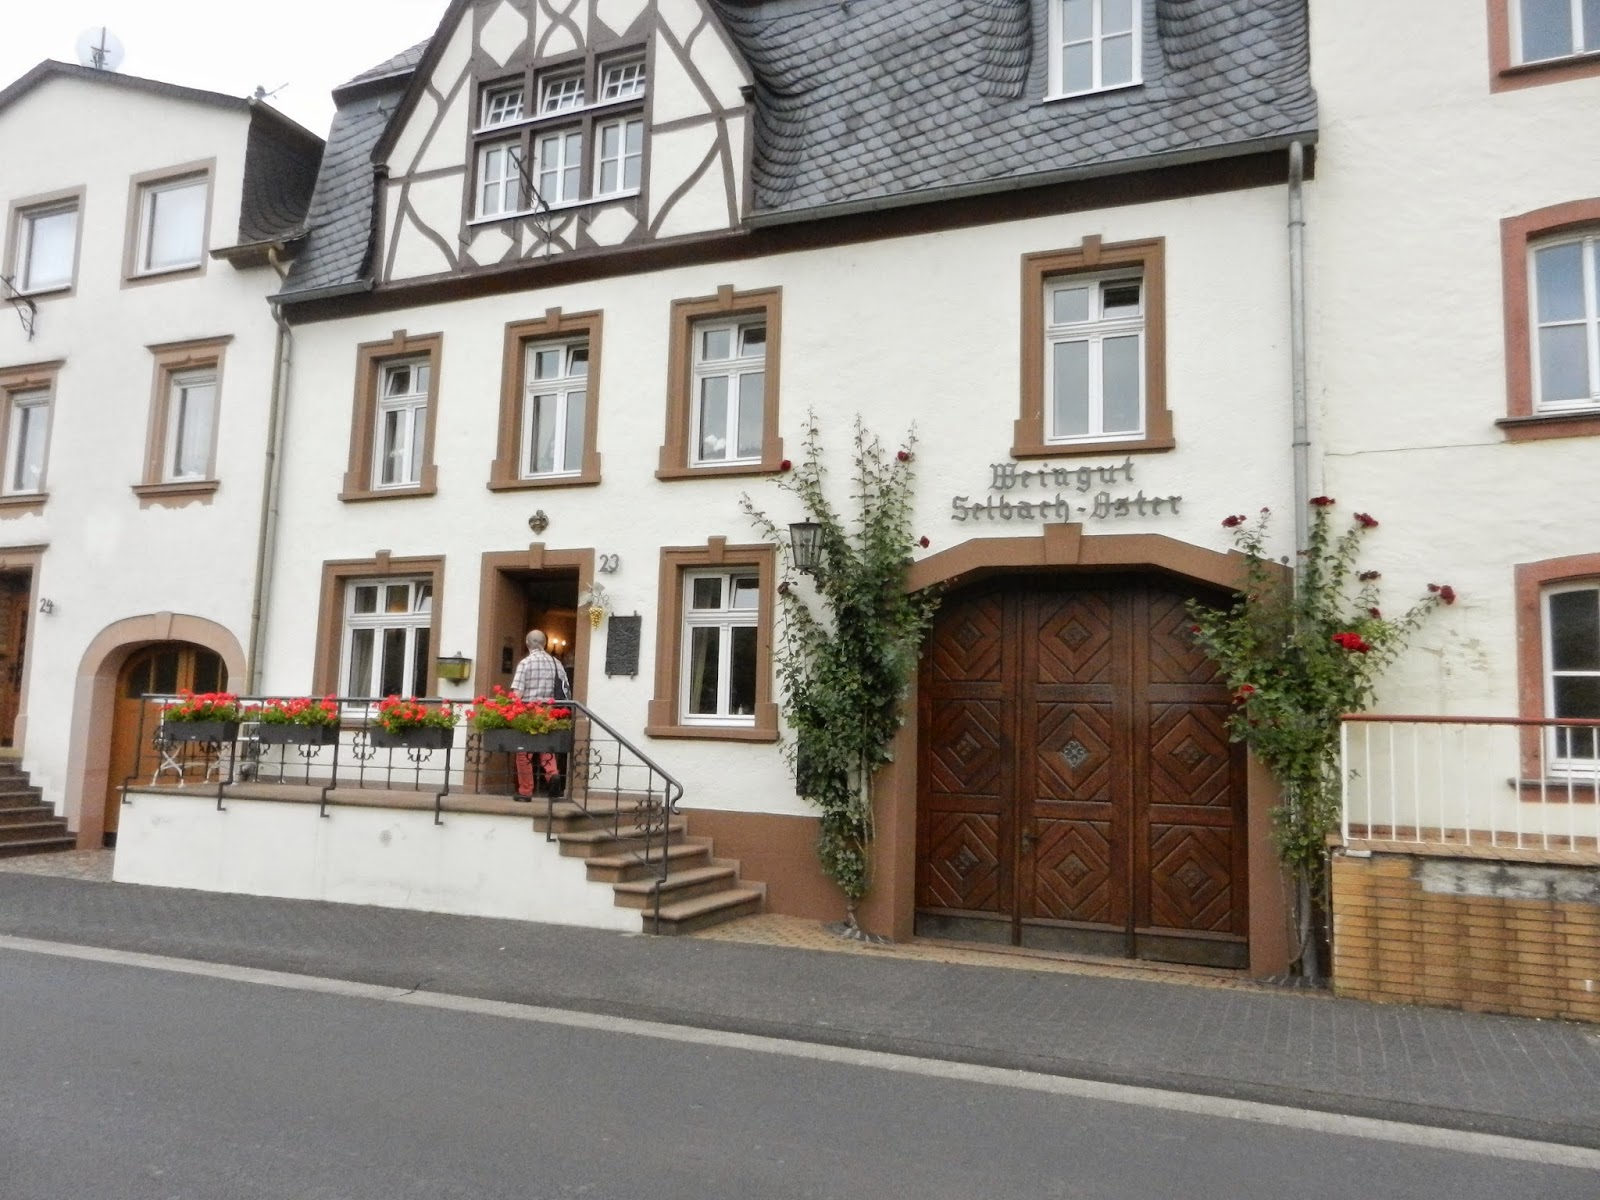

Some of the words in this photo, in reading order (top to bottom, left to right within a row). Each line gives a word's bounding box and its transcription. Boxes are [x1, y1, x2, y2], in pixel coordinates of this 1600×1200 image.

[989, 457, 1135, 493] Weingut
[598, 553, 620, 574] 23
[39, 597, 54, 614] 24
